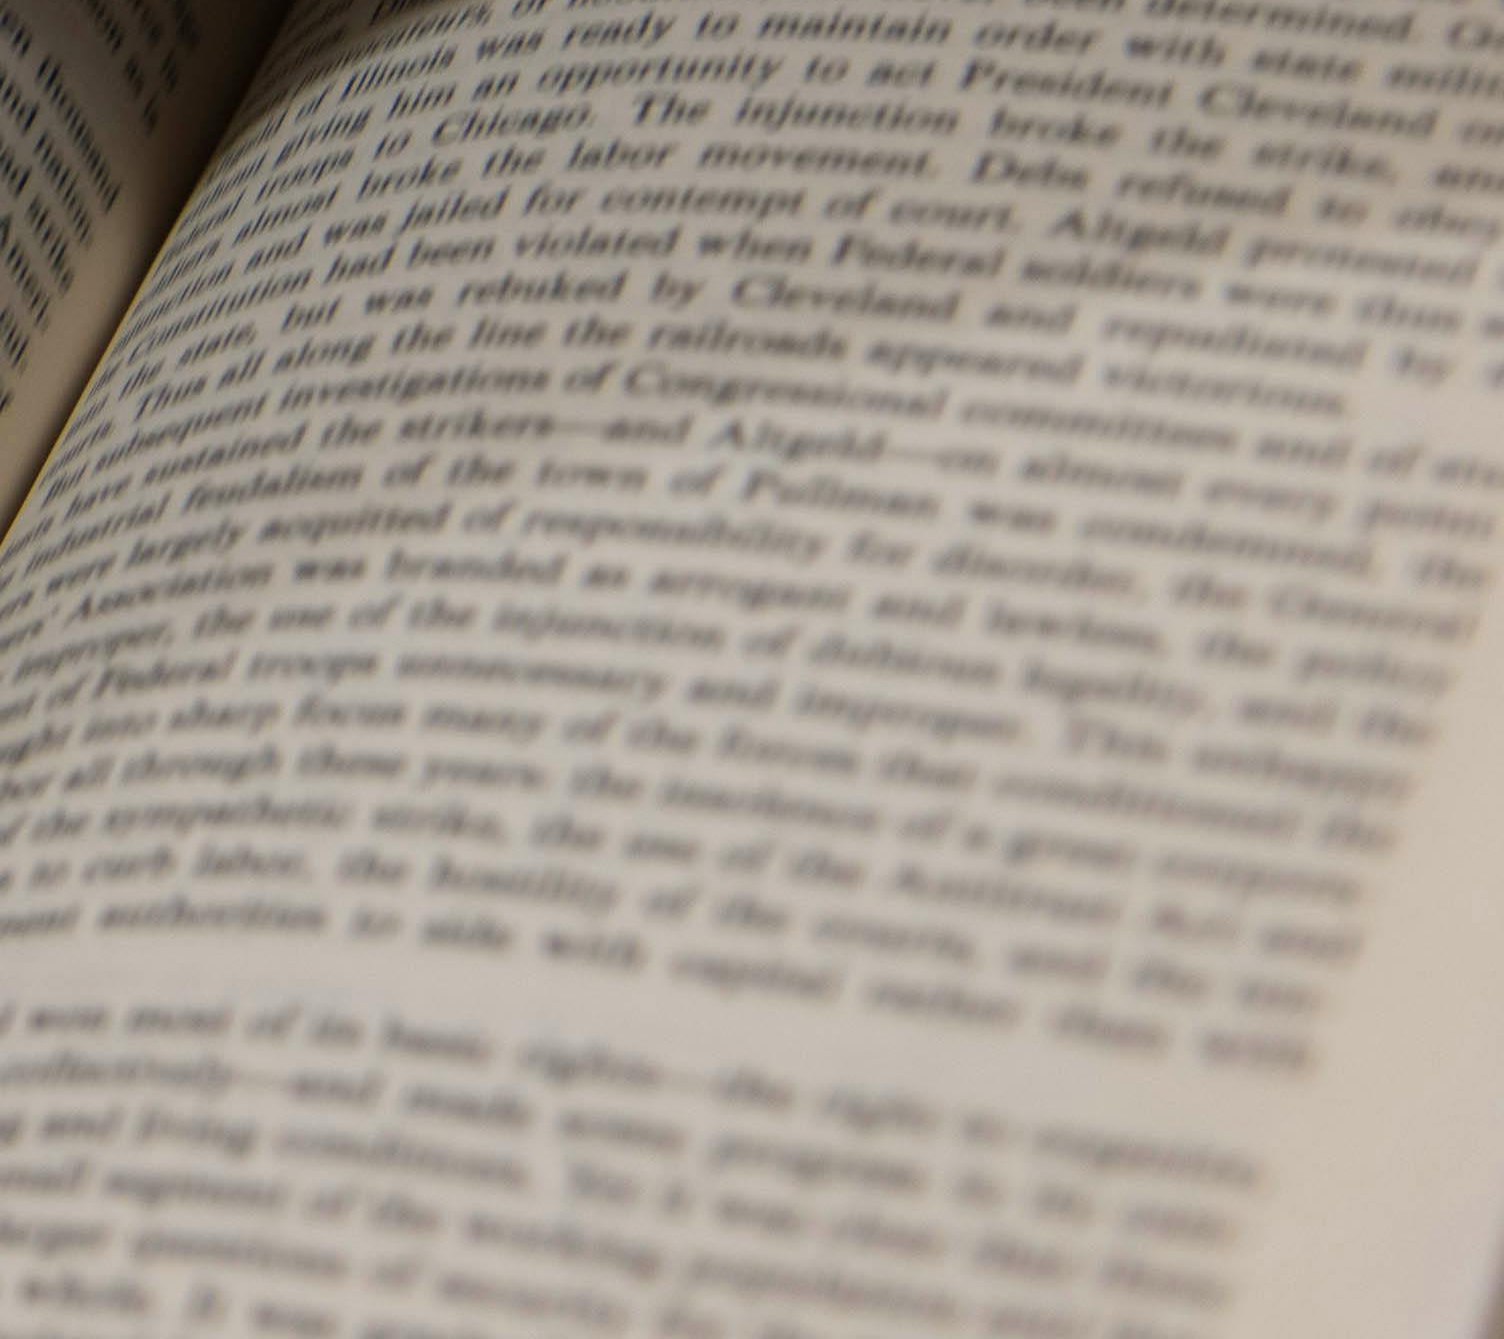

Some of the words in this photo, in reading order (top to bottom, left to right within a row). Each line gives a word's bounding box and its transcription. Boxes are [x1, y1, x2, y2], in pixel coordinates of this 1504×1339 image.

[755, 10, 953, 45] maintain
[534, 52, 784, 97] opportunity
[632, 90, 712, 129] The
[733, 95, 960, 135] injunction
[479, 144, 547, 181] the
[564, 137, 677, 173] labor
